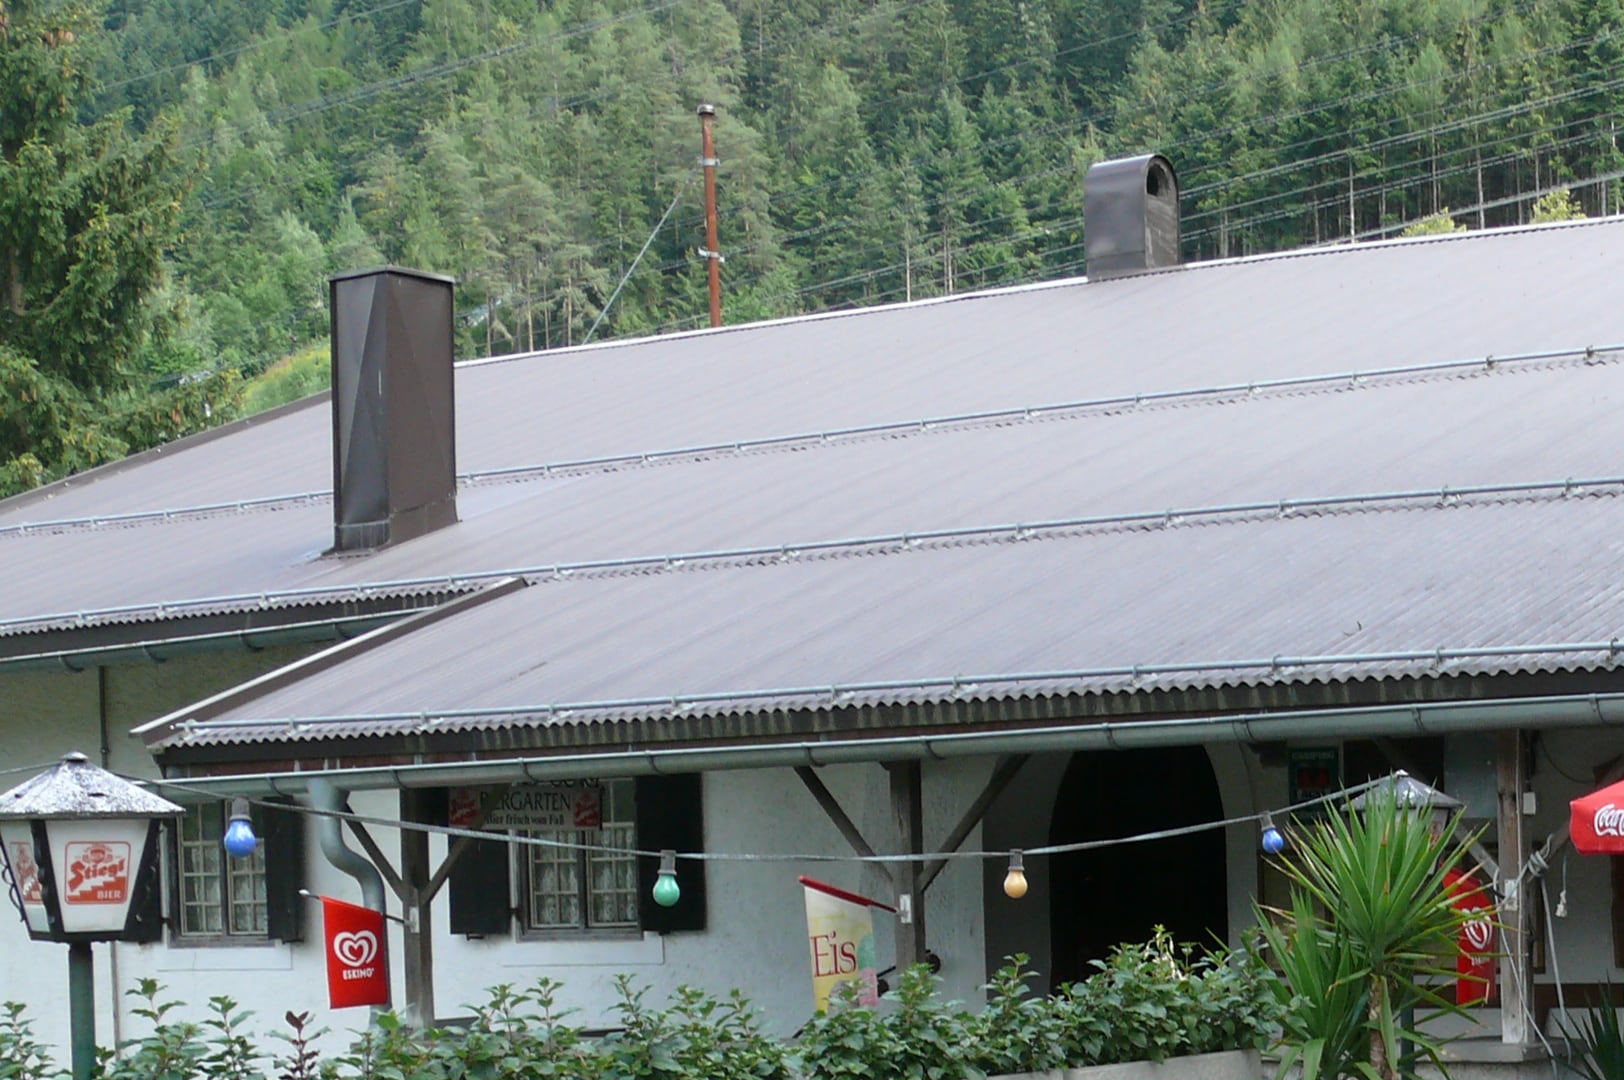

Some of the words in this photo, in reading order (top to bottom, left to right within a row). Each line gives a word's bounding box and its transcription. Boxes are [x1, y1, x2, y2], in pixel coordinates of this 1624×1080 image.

[68, 857, 126, 892] Stiegl
[97, 889, 121, 899] BIER
[811, 930, 857, 978] Eis
[343, 968, 373, 980] ESKIMO
